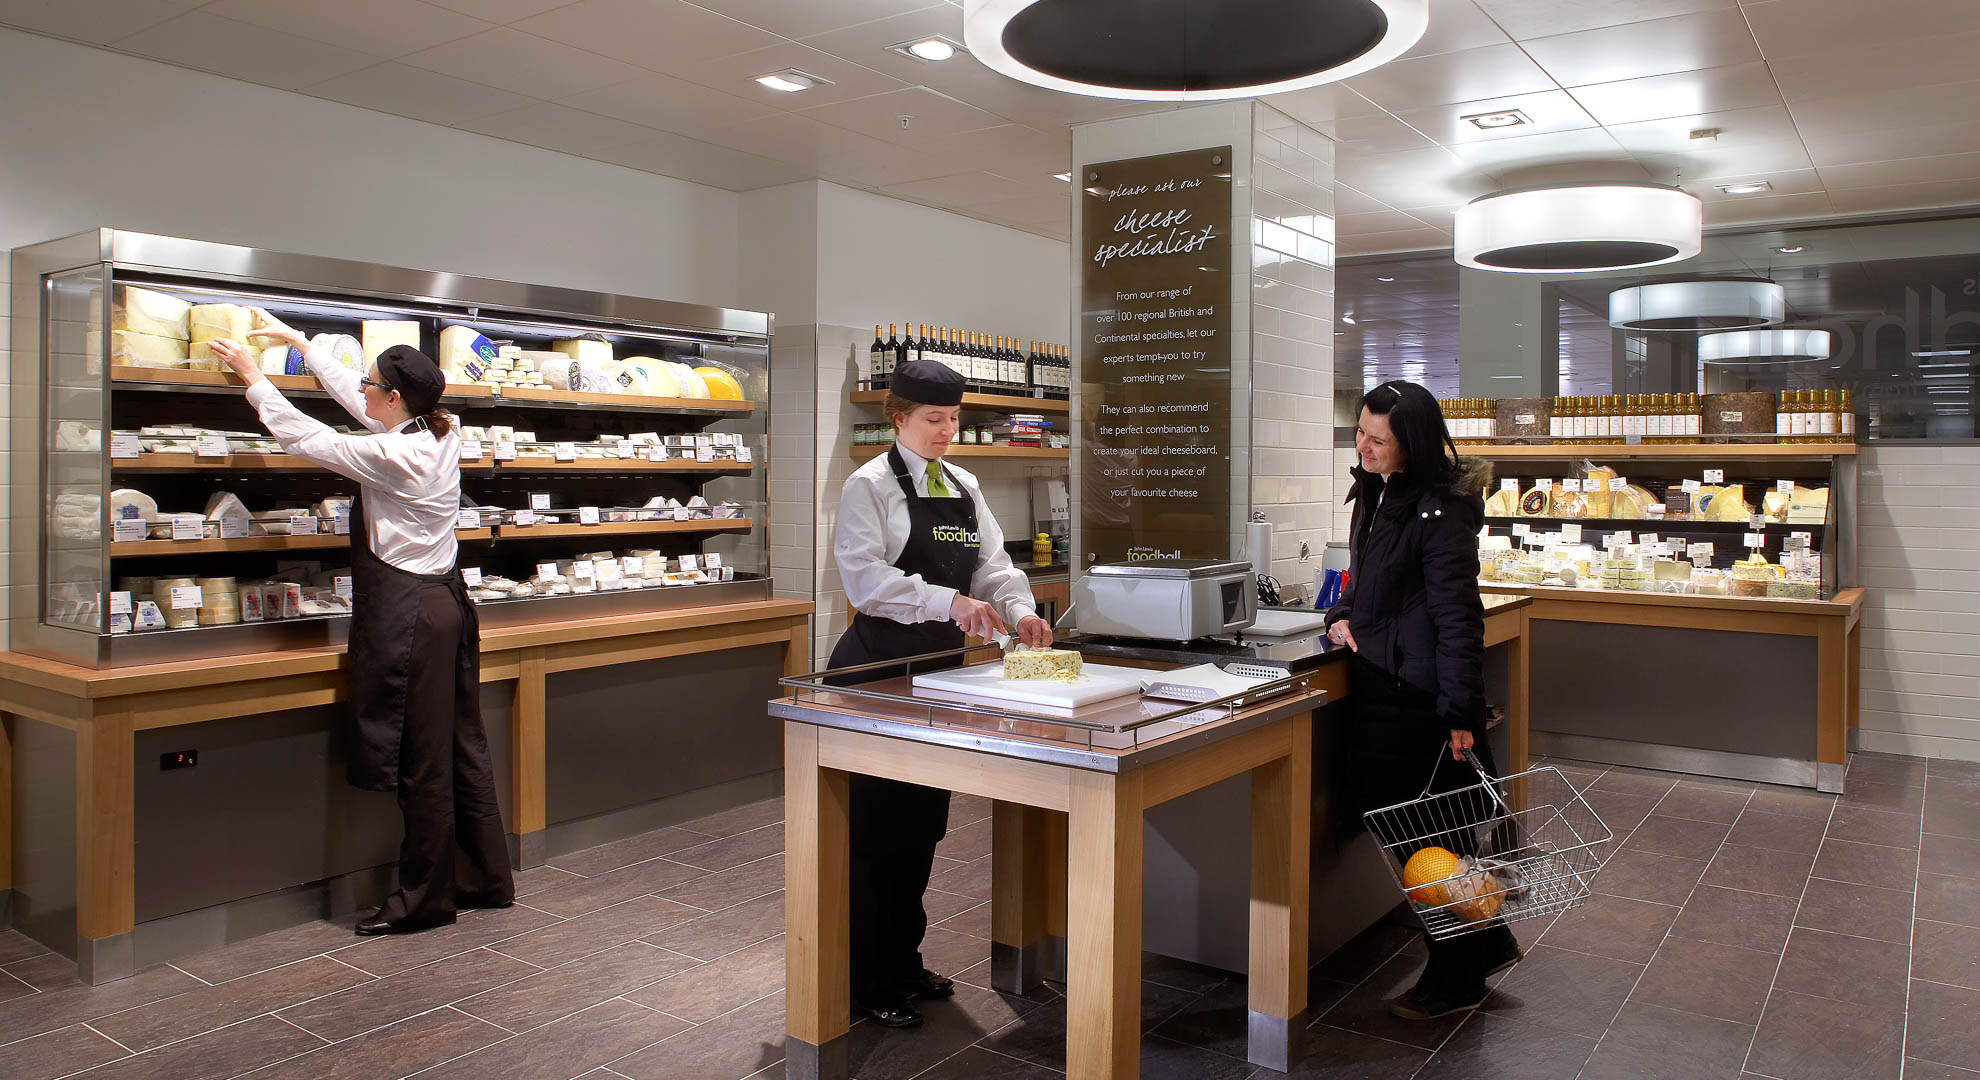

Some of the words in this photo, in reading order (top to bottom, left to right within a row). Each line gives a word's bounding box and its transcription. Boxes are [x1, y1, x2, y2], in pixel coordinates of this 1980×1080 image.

[1108, 184, 1148, 201] please
[1154, 178, 1176, 192] ask
[1180, 178, 1202, 189] our
[1114, 208, 1192, 234] cheese
[1094, 224, 1216, 268] specialist
[1116, 291, 1137, 300] From
[1157, 290, 1180, 300] range
[1182, 286, 1192, 295] of
[1096, 314, 1114, 323] over
[1117, 310, 1132, 321] 100
[1134, 308, 1166, 322] regional
[1169, 307, 1194, 317] British
[1197, 306, 1213, 316] and
[1094, 332, 1140, 344] Continental
[1187, 329, 1198, 338] let
[1200, 329, 1216, 337] our
[1103, 355, 1133, 365] experts
[1136, 353, 1161, 363] tempt
[1163, 352, 1179, 363] you
[1181, 351, 1191, 359] to
[1193, 350, 1206, 360] try
[1122, 373, 1164, 384] something
[1166, 373, 1185, 381] new
[1100, 404, 1120, 416] They
[1123, 406, 1136, 414] can
[1139, 404, 1155, 413] also
[1157, 402, 1209, 413] recommend
[1100, 426, 1113, 434] the
[1115, 425, 1143, 436] perfect
[1146, 424, 1197, 434] combination
[1200, 424, 1210, 432] to
[1093, 447, 1117, 455] create
[1120, 448, 1139, 456] your
[1140, 445, 1160, 455] ideal
[1103, 468, 1113, 476] or
[1114, 467, 1129, 478] just
[1131, 467, 1144, 476] cut
[1146, 468, 1162, 478] you
[1171, 466, 1194, 478] piece
[1196, 466, 1207, 476] of
[1110, 489, 1128, 498] your
[1131, 487, 1166, 497] favourite
[1169, 488, 1198, 497] cheese
[932, 526, 980, 542] foodhal
[1127, 548, 1181, 561] foodhall
